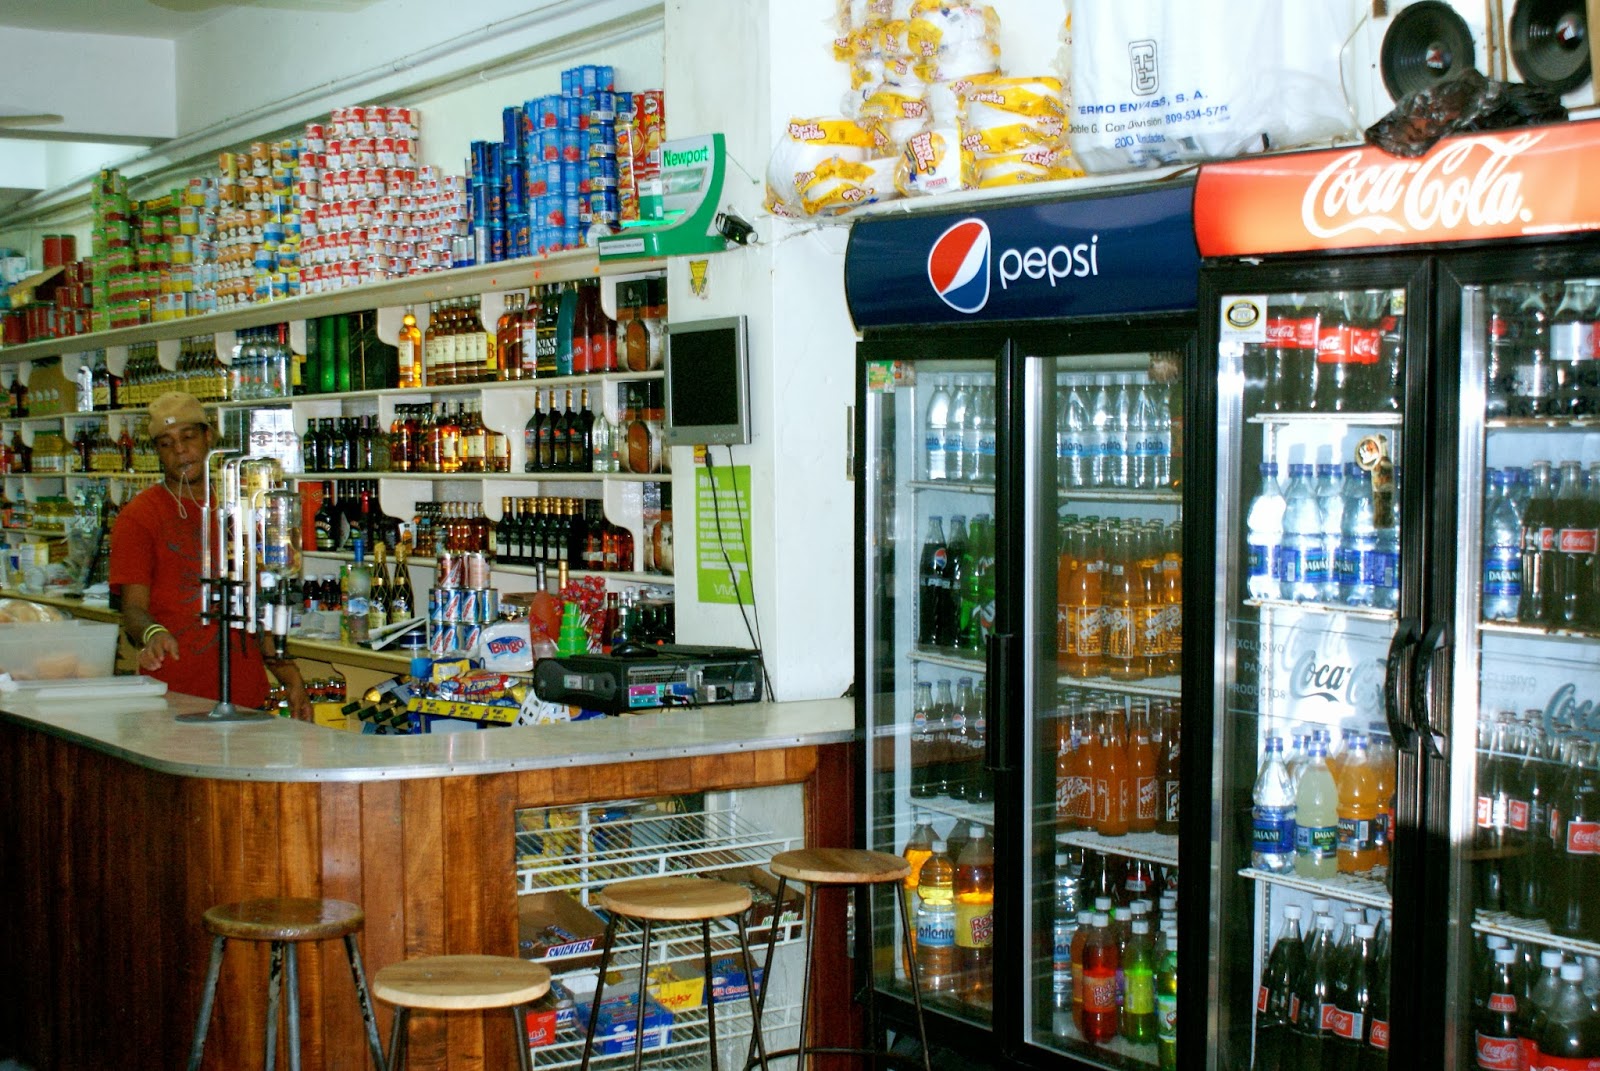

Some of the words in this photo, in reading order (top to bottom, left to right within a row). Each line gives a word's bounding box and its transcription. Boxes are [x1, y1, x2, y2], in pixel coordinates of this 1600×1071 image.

[1078, 104, 1116, 115] ERMO
[1114, 136, 1134, 148] 200
[663, 145, 708, 168] Newport
[1301, 131, 1548, 238] Coca-Cola
[1000, 234, 1098, 290] pepsi
[490, 637, 526, 654] Bingo
[549, 940, 593, 957] SNICKERS
